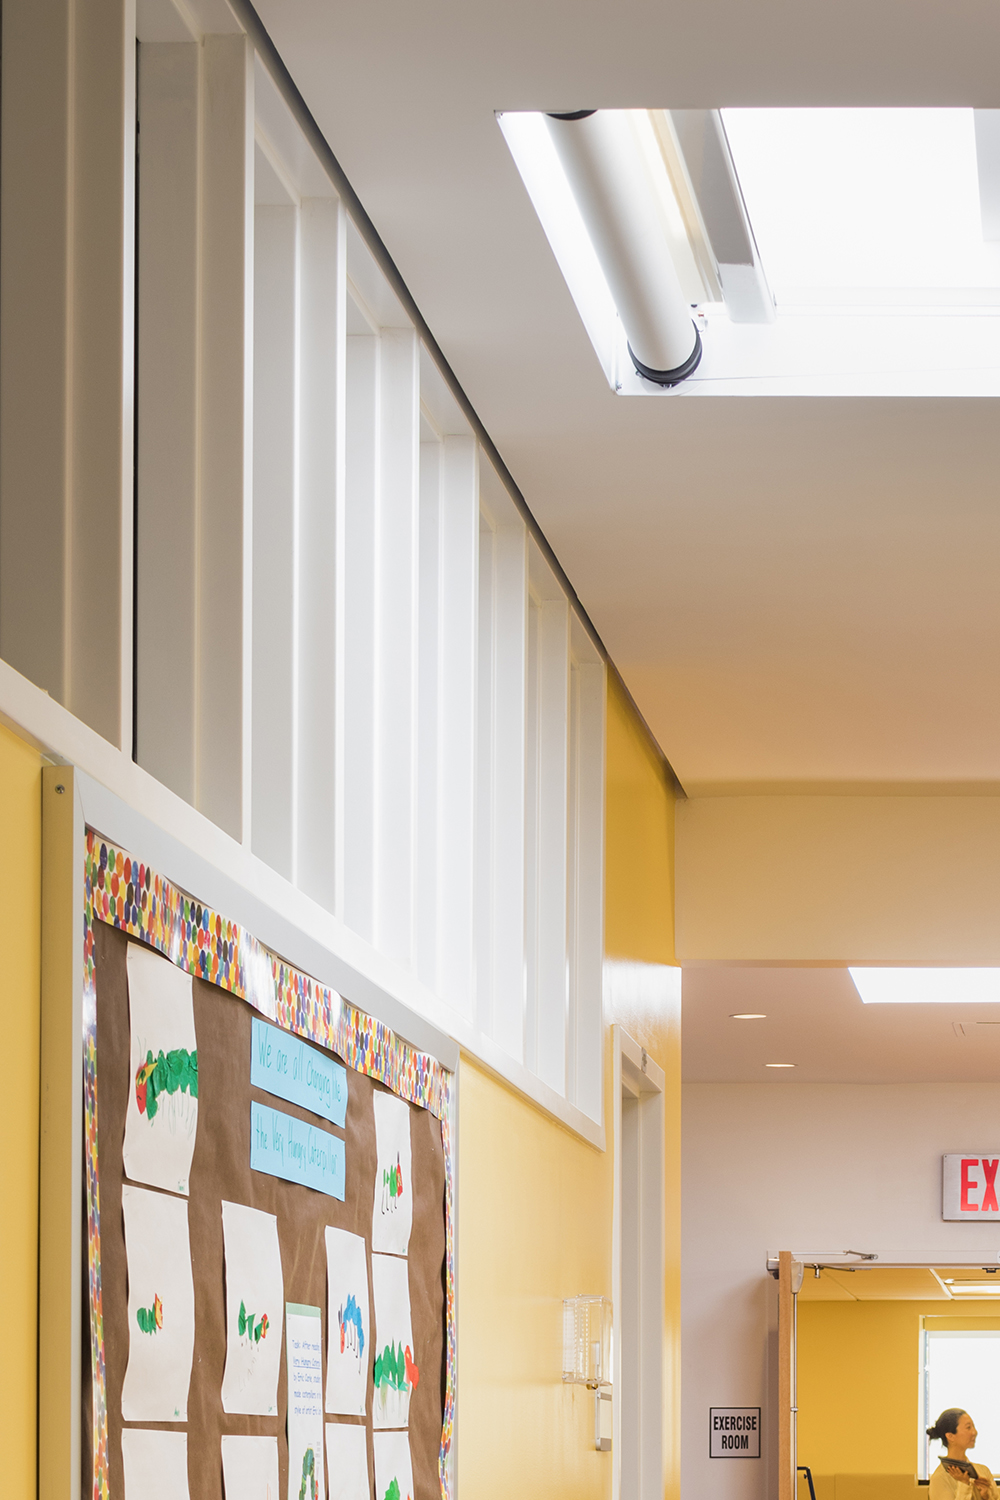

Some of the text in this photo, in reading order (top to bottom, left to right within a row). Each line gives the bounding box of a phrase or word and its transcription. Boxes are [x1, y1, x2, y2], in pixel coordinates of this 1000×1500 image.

[257, 1023, 272, 1069] We
[276, 1049, 288, 1075] are
[292, 1043, 304, 1082] all
[256, 1112, 267, 1150] the
[713, 1415, 757, 1431] EXERCISE
[721, 1434, 749, 1450] ROOM
